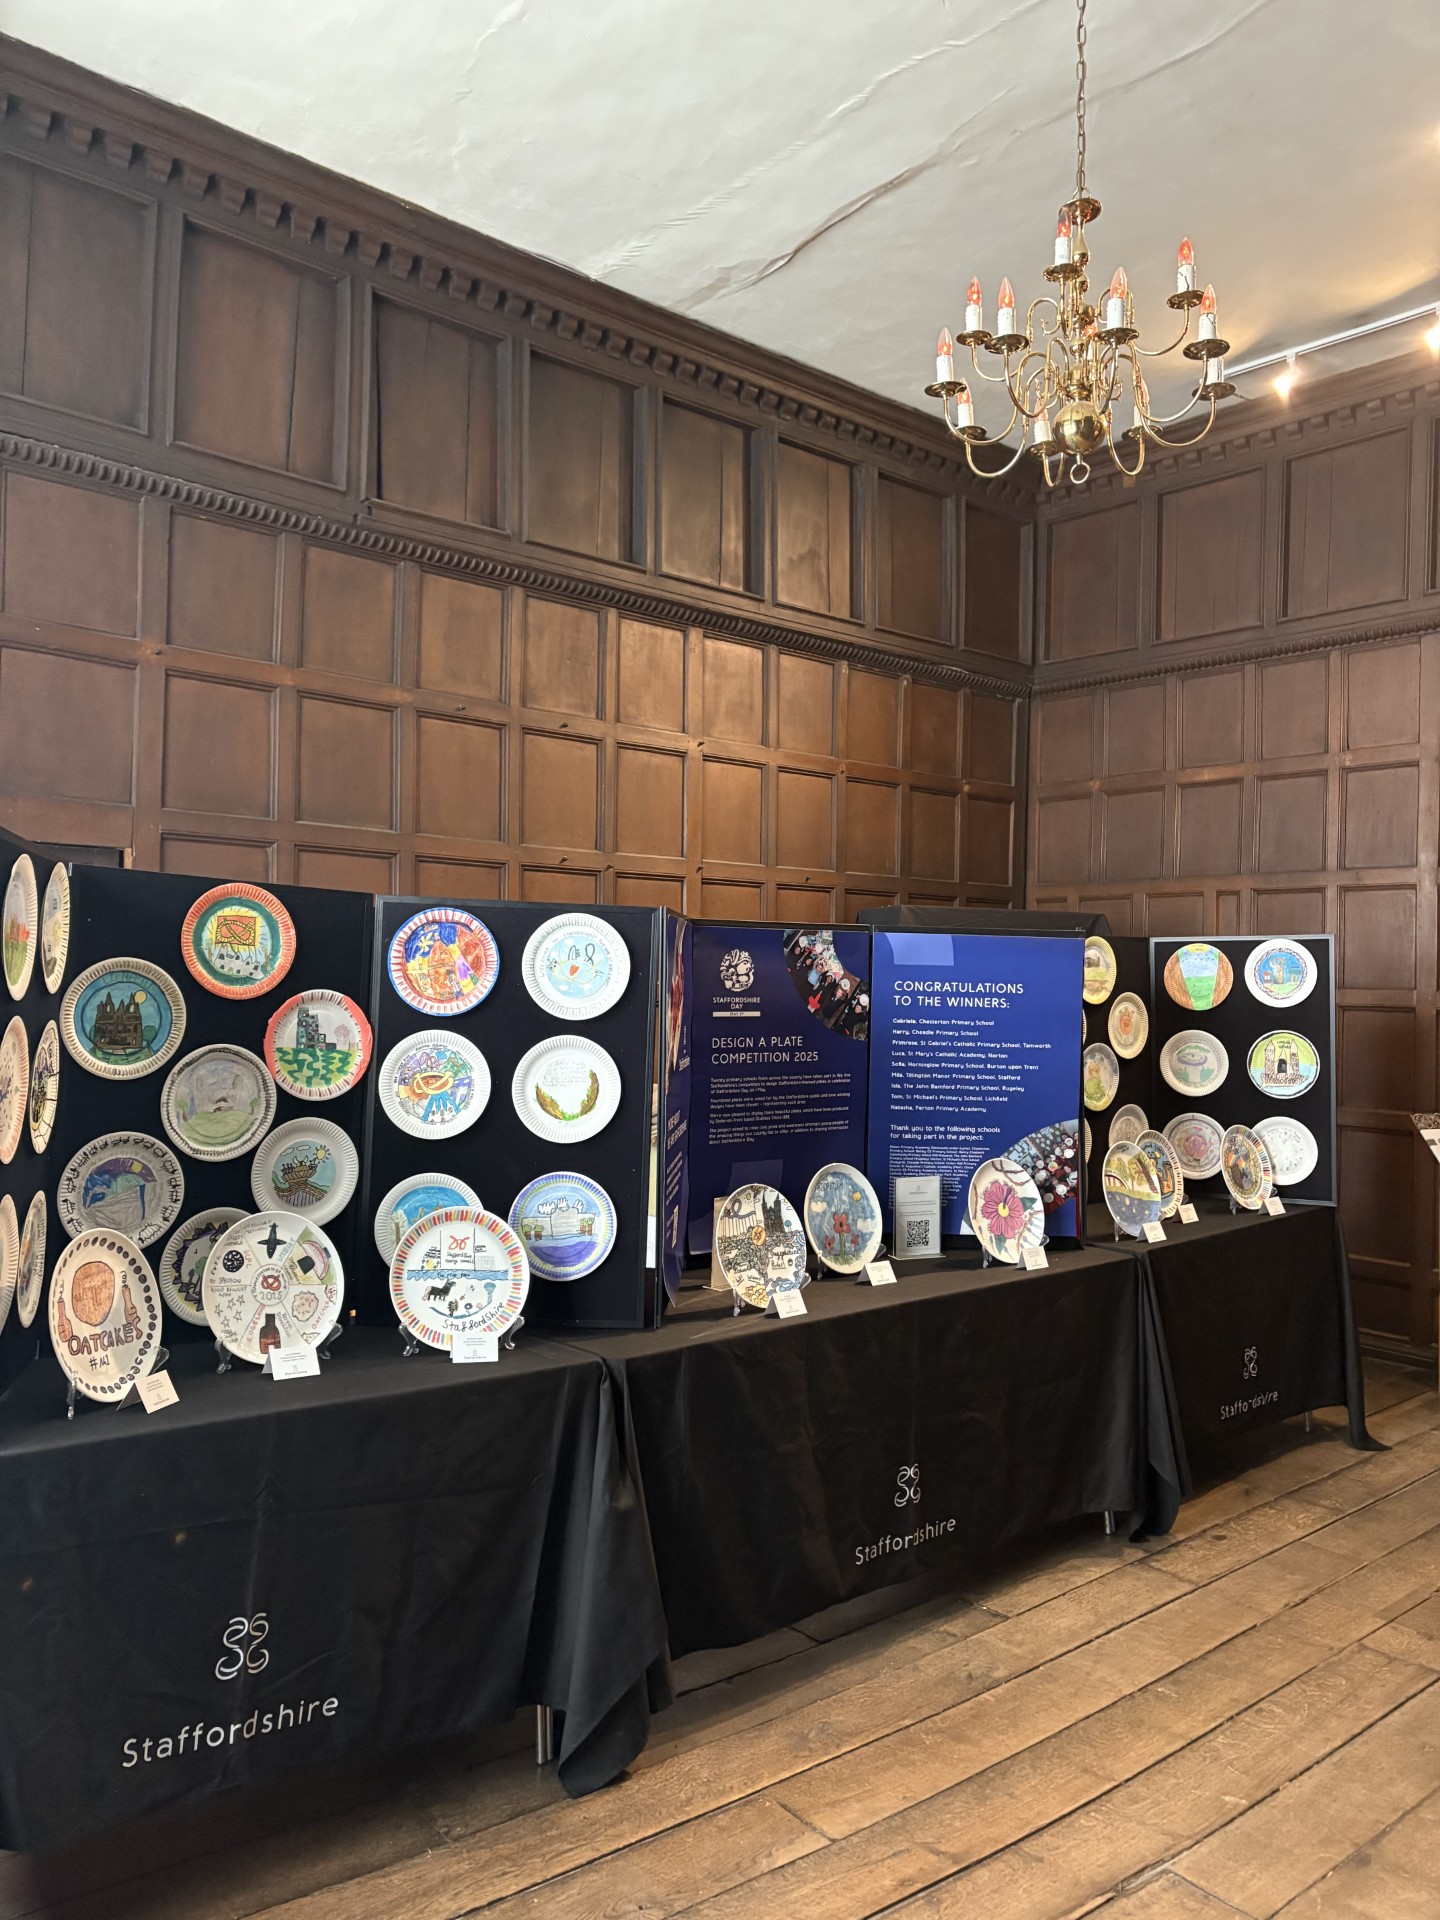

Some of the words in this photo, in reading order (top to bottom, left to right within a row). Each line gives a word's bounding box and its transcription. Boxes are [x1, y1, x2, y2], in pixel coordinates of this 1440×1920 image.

[894, 980, 1023, 994] CONGRATULATIONS
[893, 995, 911, 1005] TO
[916, 995, 941, 1006] THE
[946, 996, 1010, 1008] WINNERS:
[712, 1036, 754, 1048] DESIGN
[759, 1038, 766, 1047] A
[771, 1036, 803, 1047] PLATE
[711, 1052, 790, 1064] COMPETITION
[794, 1051, 818, 1062] 2025
[67, 1317, 142, 1356] OATCAKES
[855, 1519, 956, 1565] Staffordshire
[122, 1697, 339, 1768] Staffordshire
